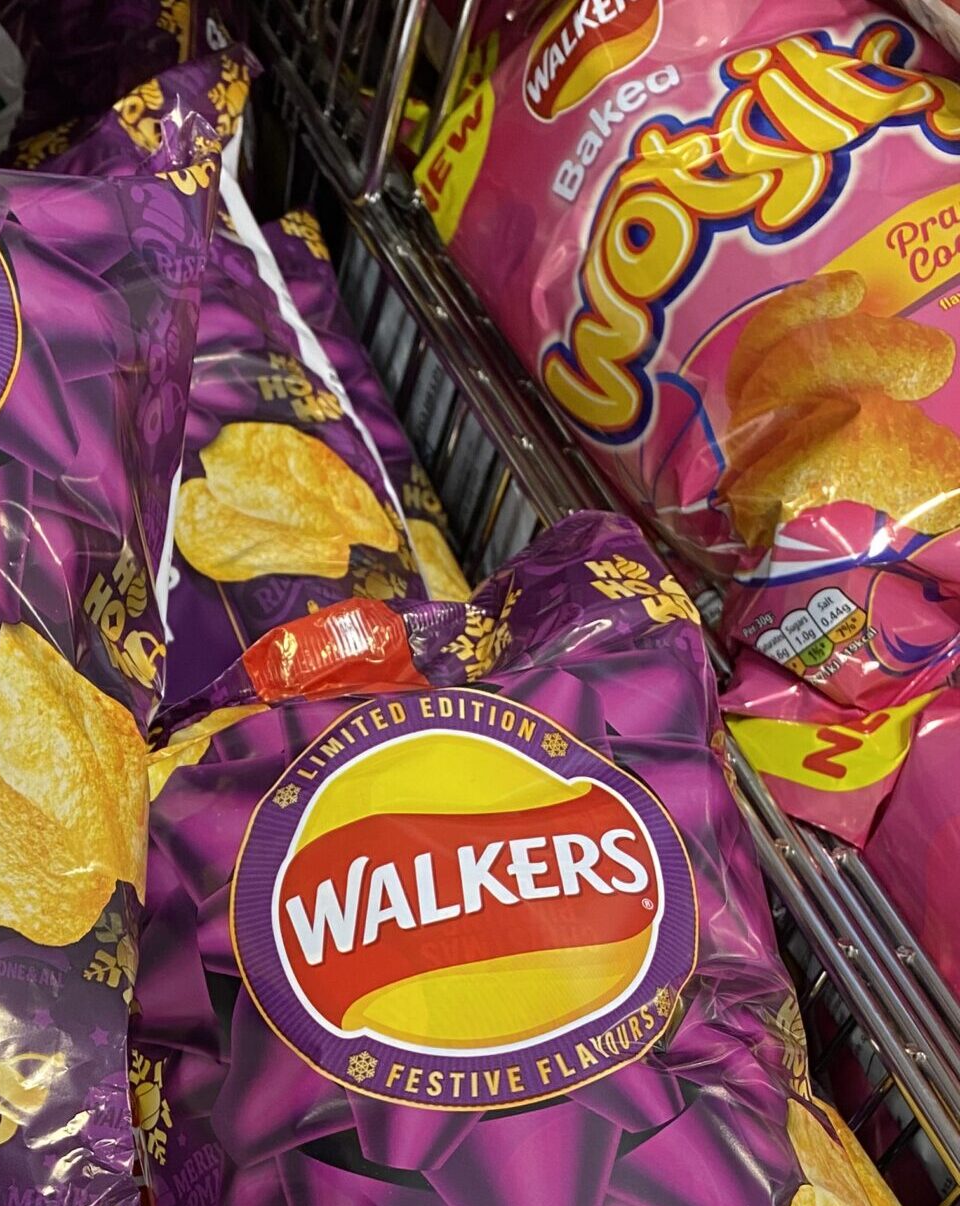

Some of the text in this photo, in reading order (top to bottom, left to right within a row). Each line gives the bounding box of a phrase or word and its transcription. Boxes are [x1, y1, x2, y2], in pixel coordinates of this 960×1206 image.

[525, 0, 632, 105] WALKE
[552, 64, 681, 203] Baked
[817, 596, 834, 610] Salt
[297, 697, 537, 781] LIMITED EDITION
[285, 828, 651, 968] WALKERS
[386, 1003, 657, 1098] FESTIVE FLAVOURS
